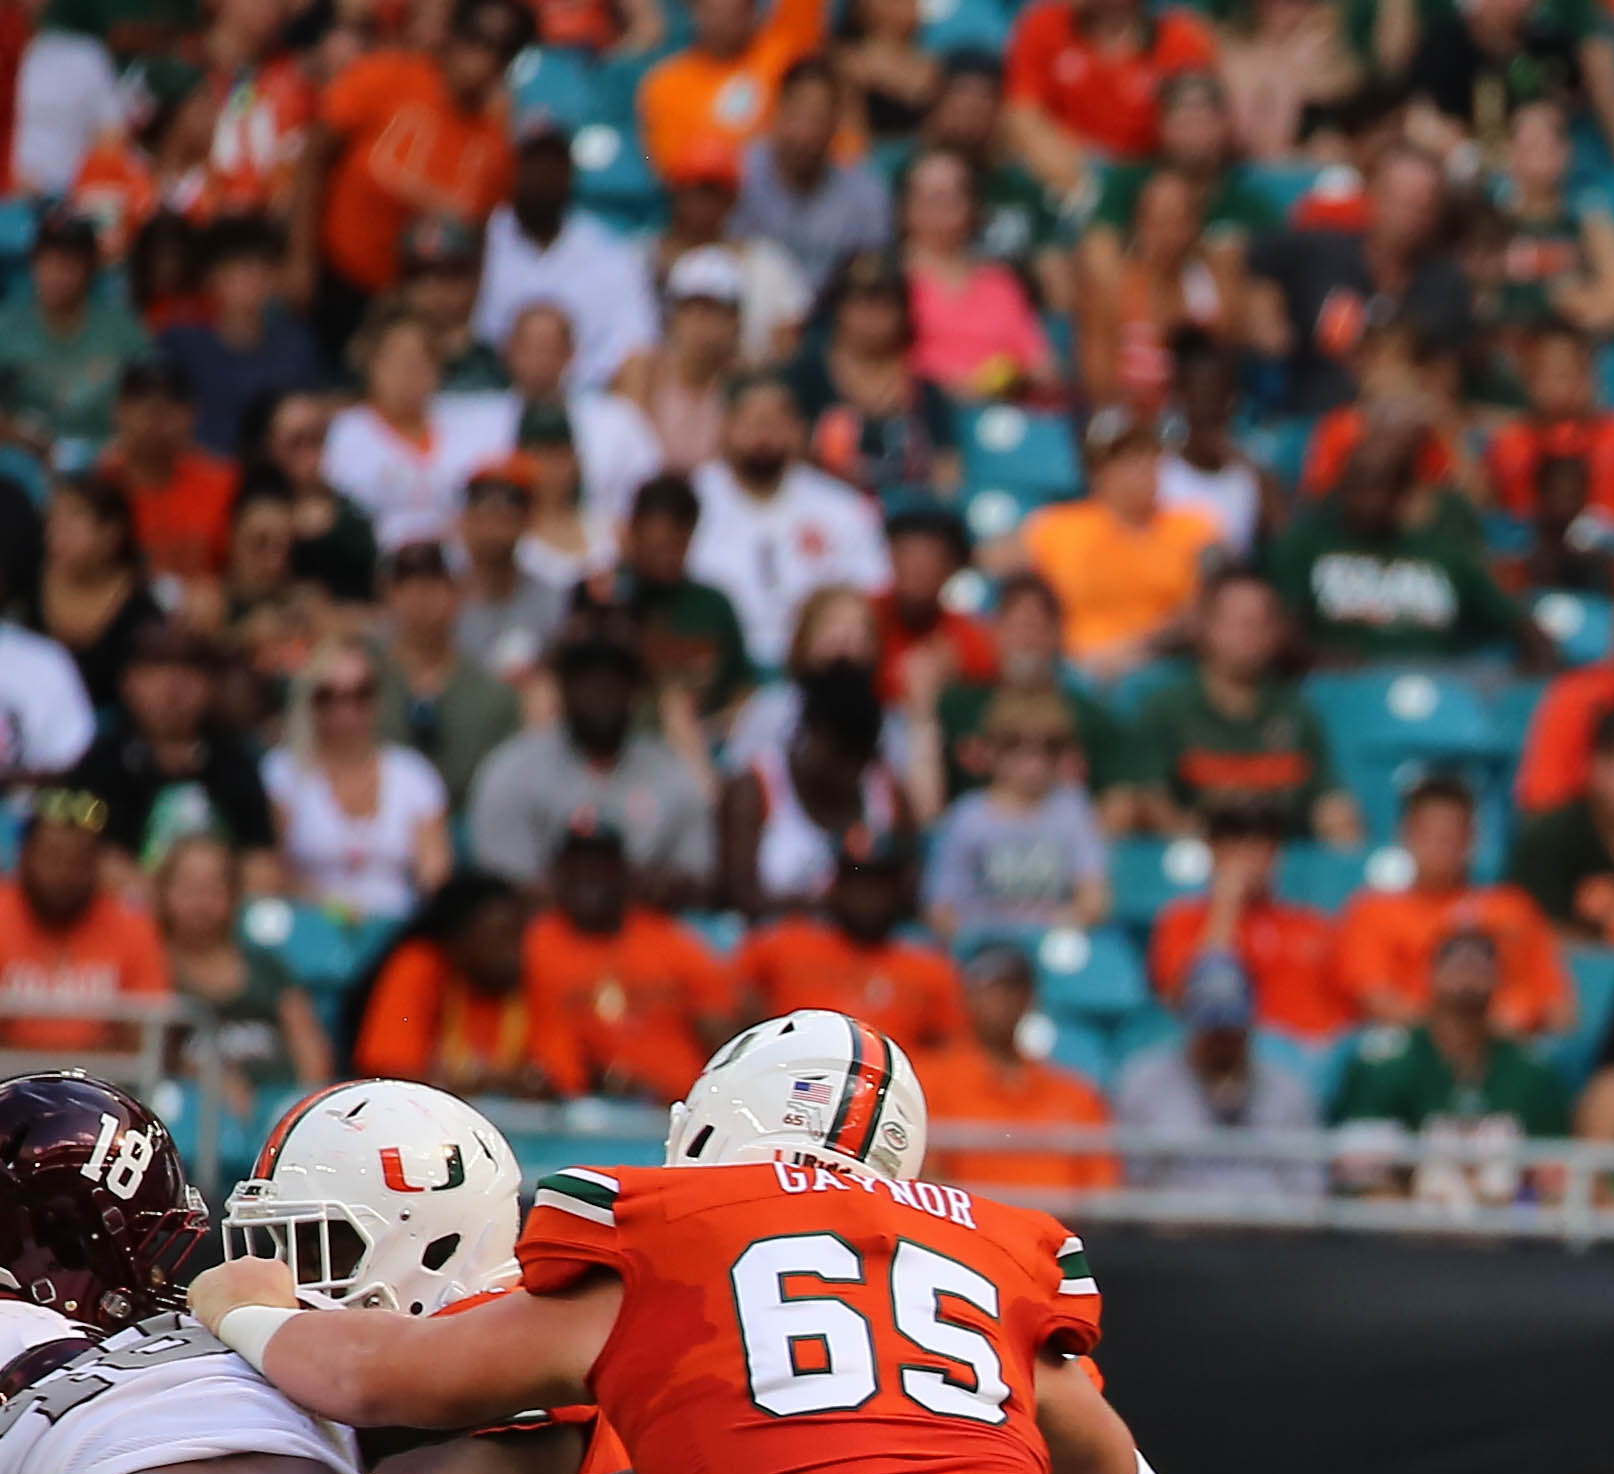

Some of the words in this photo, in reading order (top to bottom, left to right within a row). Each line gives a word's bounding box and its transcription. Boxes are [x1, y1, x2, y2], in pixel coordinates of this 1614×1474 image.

[782, 1113, 806, 1126] 65
[81, 1112, 157, 1199] 18
[378, 1144, 466, 1193] U
[773, 1160, 978, 1231] GAYNOR
[731, 1231, 1011, 1425] 65
